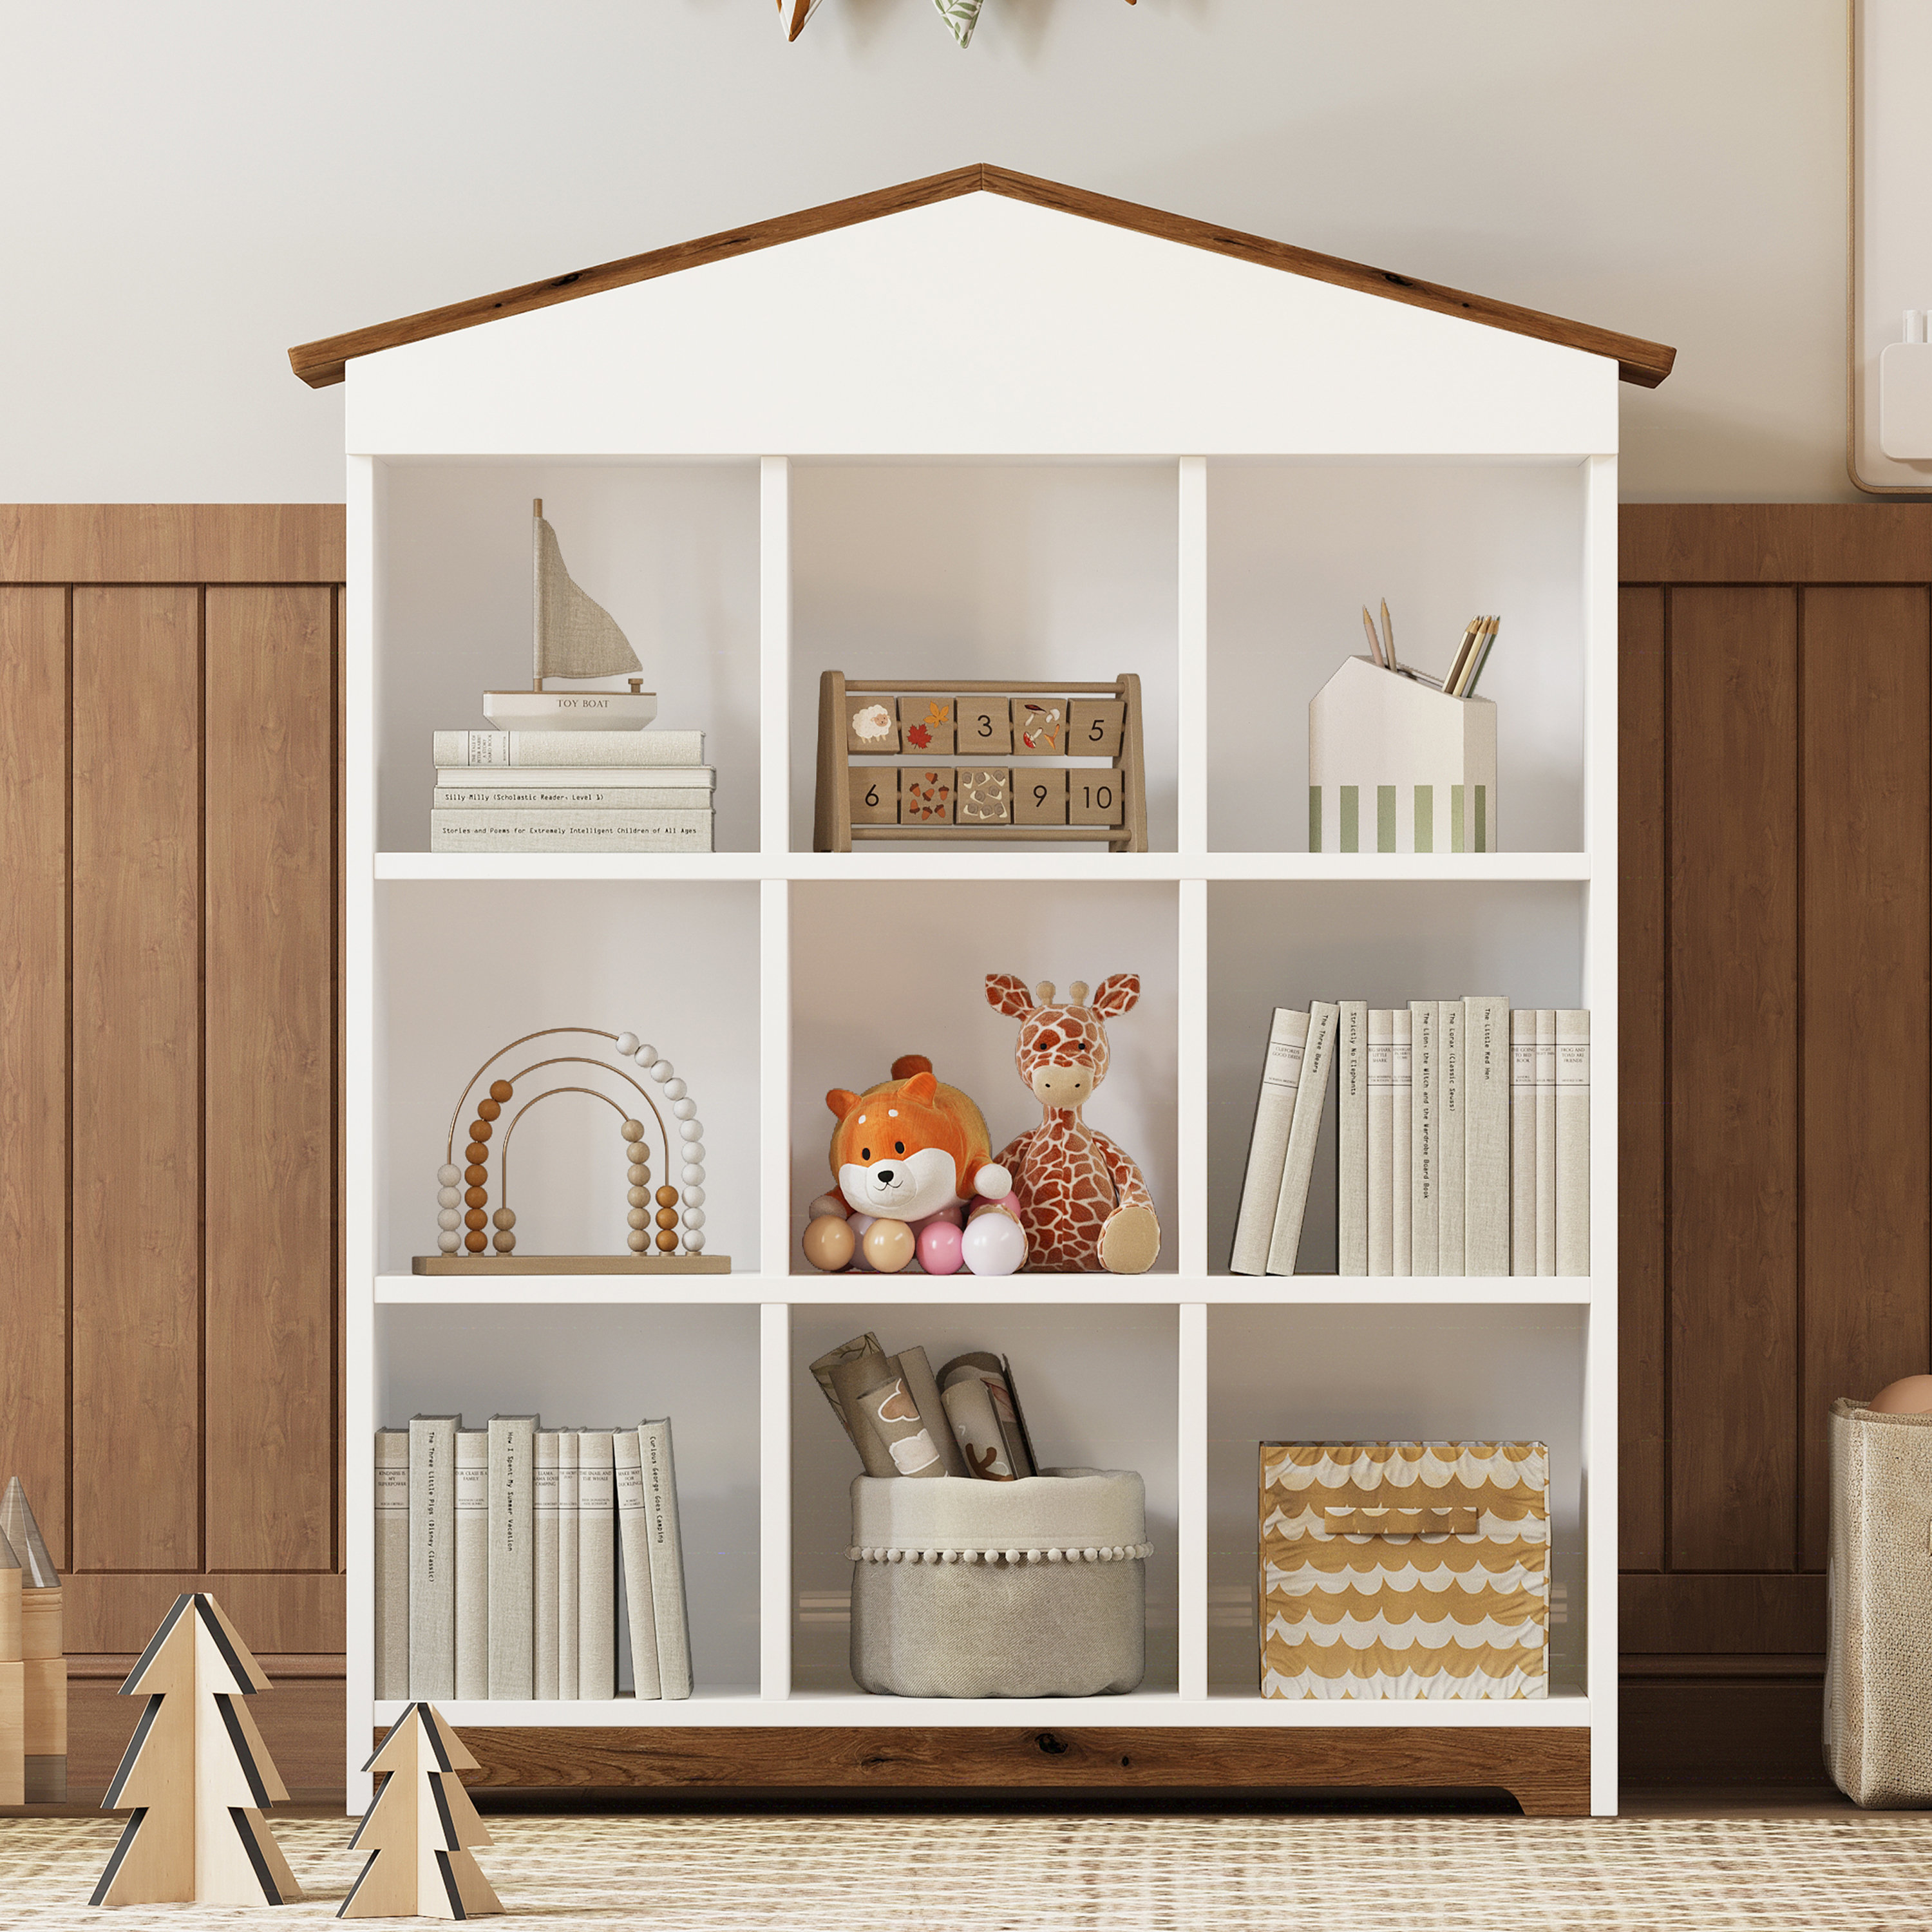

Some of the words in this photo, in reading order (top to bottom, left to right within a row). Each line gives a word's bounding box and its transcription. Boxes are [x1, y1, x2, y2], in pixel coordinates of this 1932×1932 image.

[556, 699, 578, 708] TOY
[583, 699, 609, 708] BOAT
[978, 715, 993, 737] 3
[1088, 719, 1104, 741] 5
[445, 793, 466, 802] Silly
[468, 793, 489, 802] Milly
[493, 793, 536, 802] (Scholastic
[865, 784, 880, 807] 6
[1033, 784, 1048, 808] 9
[1083, 786, 1113, 809] 10
[529, 827, 566, 836] Extremely
[569, 827, 613, 836] Intelligent
[680, 827, 697, 836] Ages
[1320, 1014, 1329, 1027] The
[1317, 1030, 1326, 1050] Three
[1350, 1048, 1357, 1057] No
[1312, 1053, 1322, 1074] Bears
[506, 1479, 514, 1488] My
[427, 1499, 435, 1515] Pigs
[427, 1519, 435, 1548] (Disney
